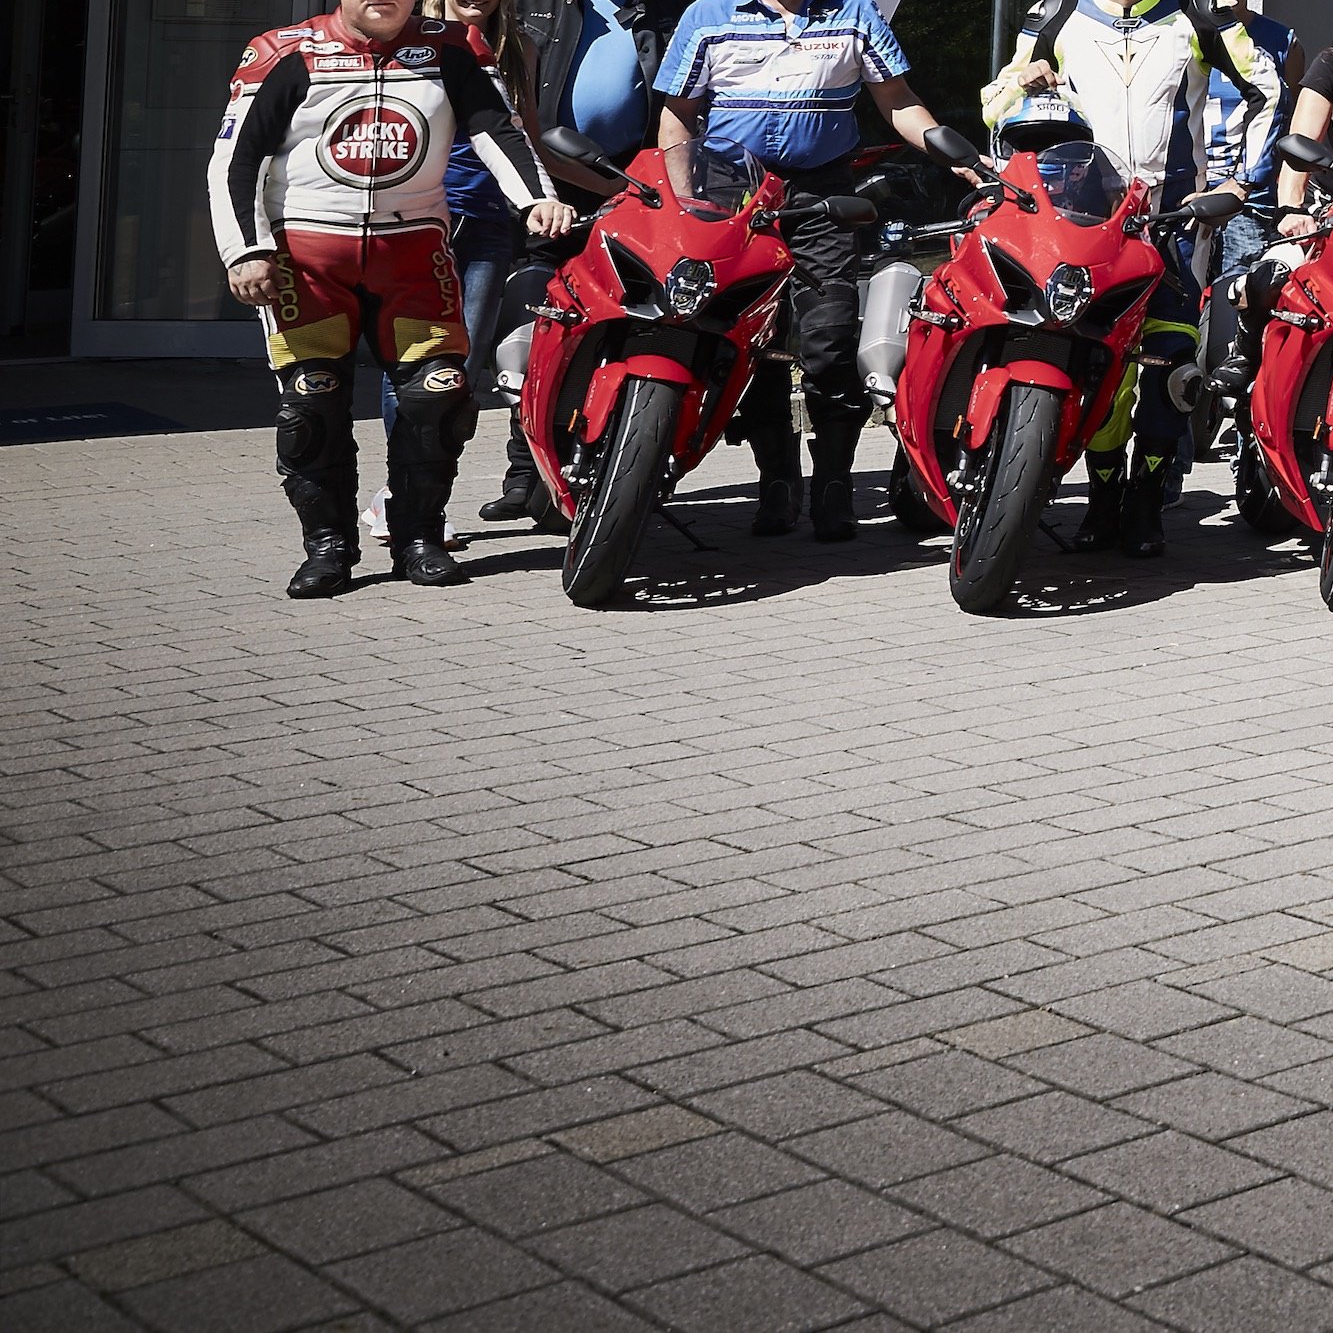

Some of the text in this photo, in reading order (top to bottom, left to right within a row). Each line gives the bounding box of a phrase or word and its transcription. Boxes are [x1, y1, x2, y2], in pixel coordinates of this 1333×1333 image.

[794, 41, 846, 52] SUZUKI
[318, 58, 360, 68] MOTUL
[342, 122, 408, 141] LUCKY
[336, 141, 409, 160] STRIKE
